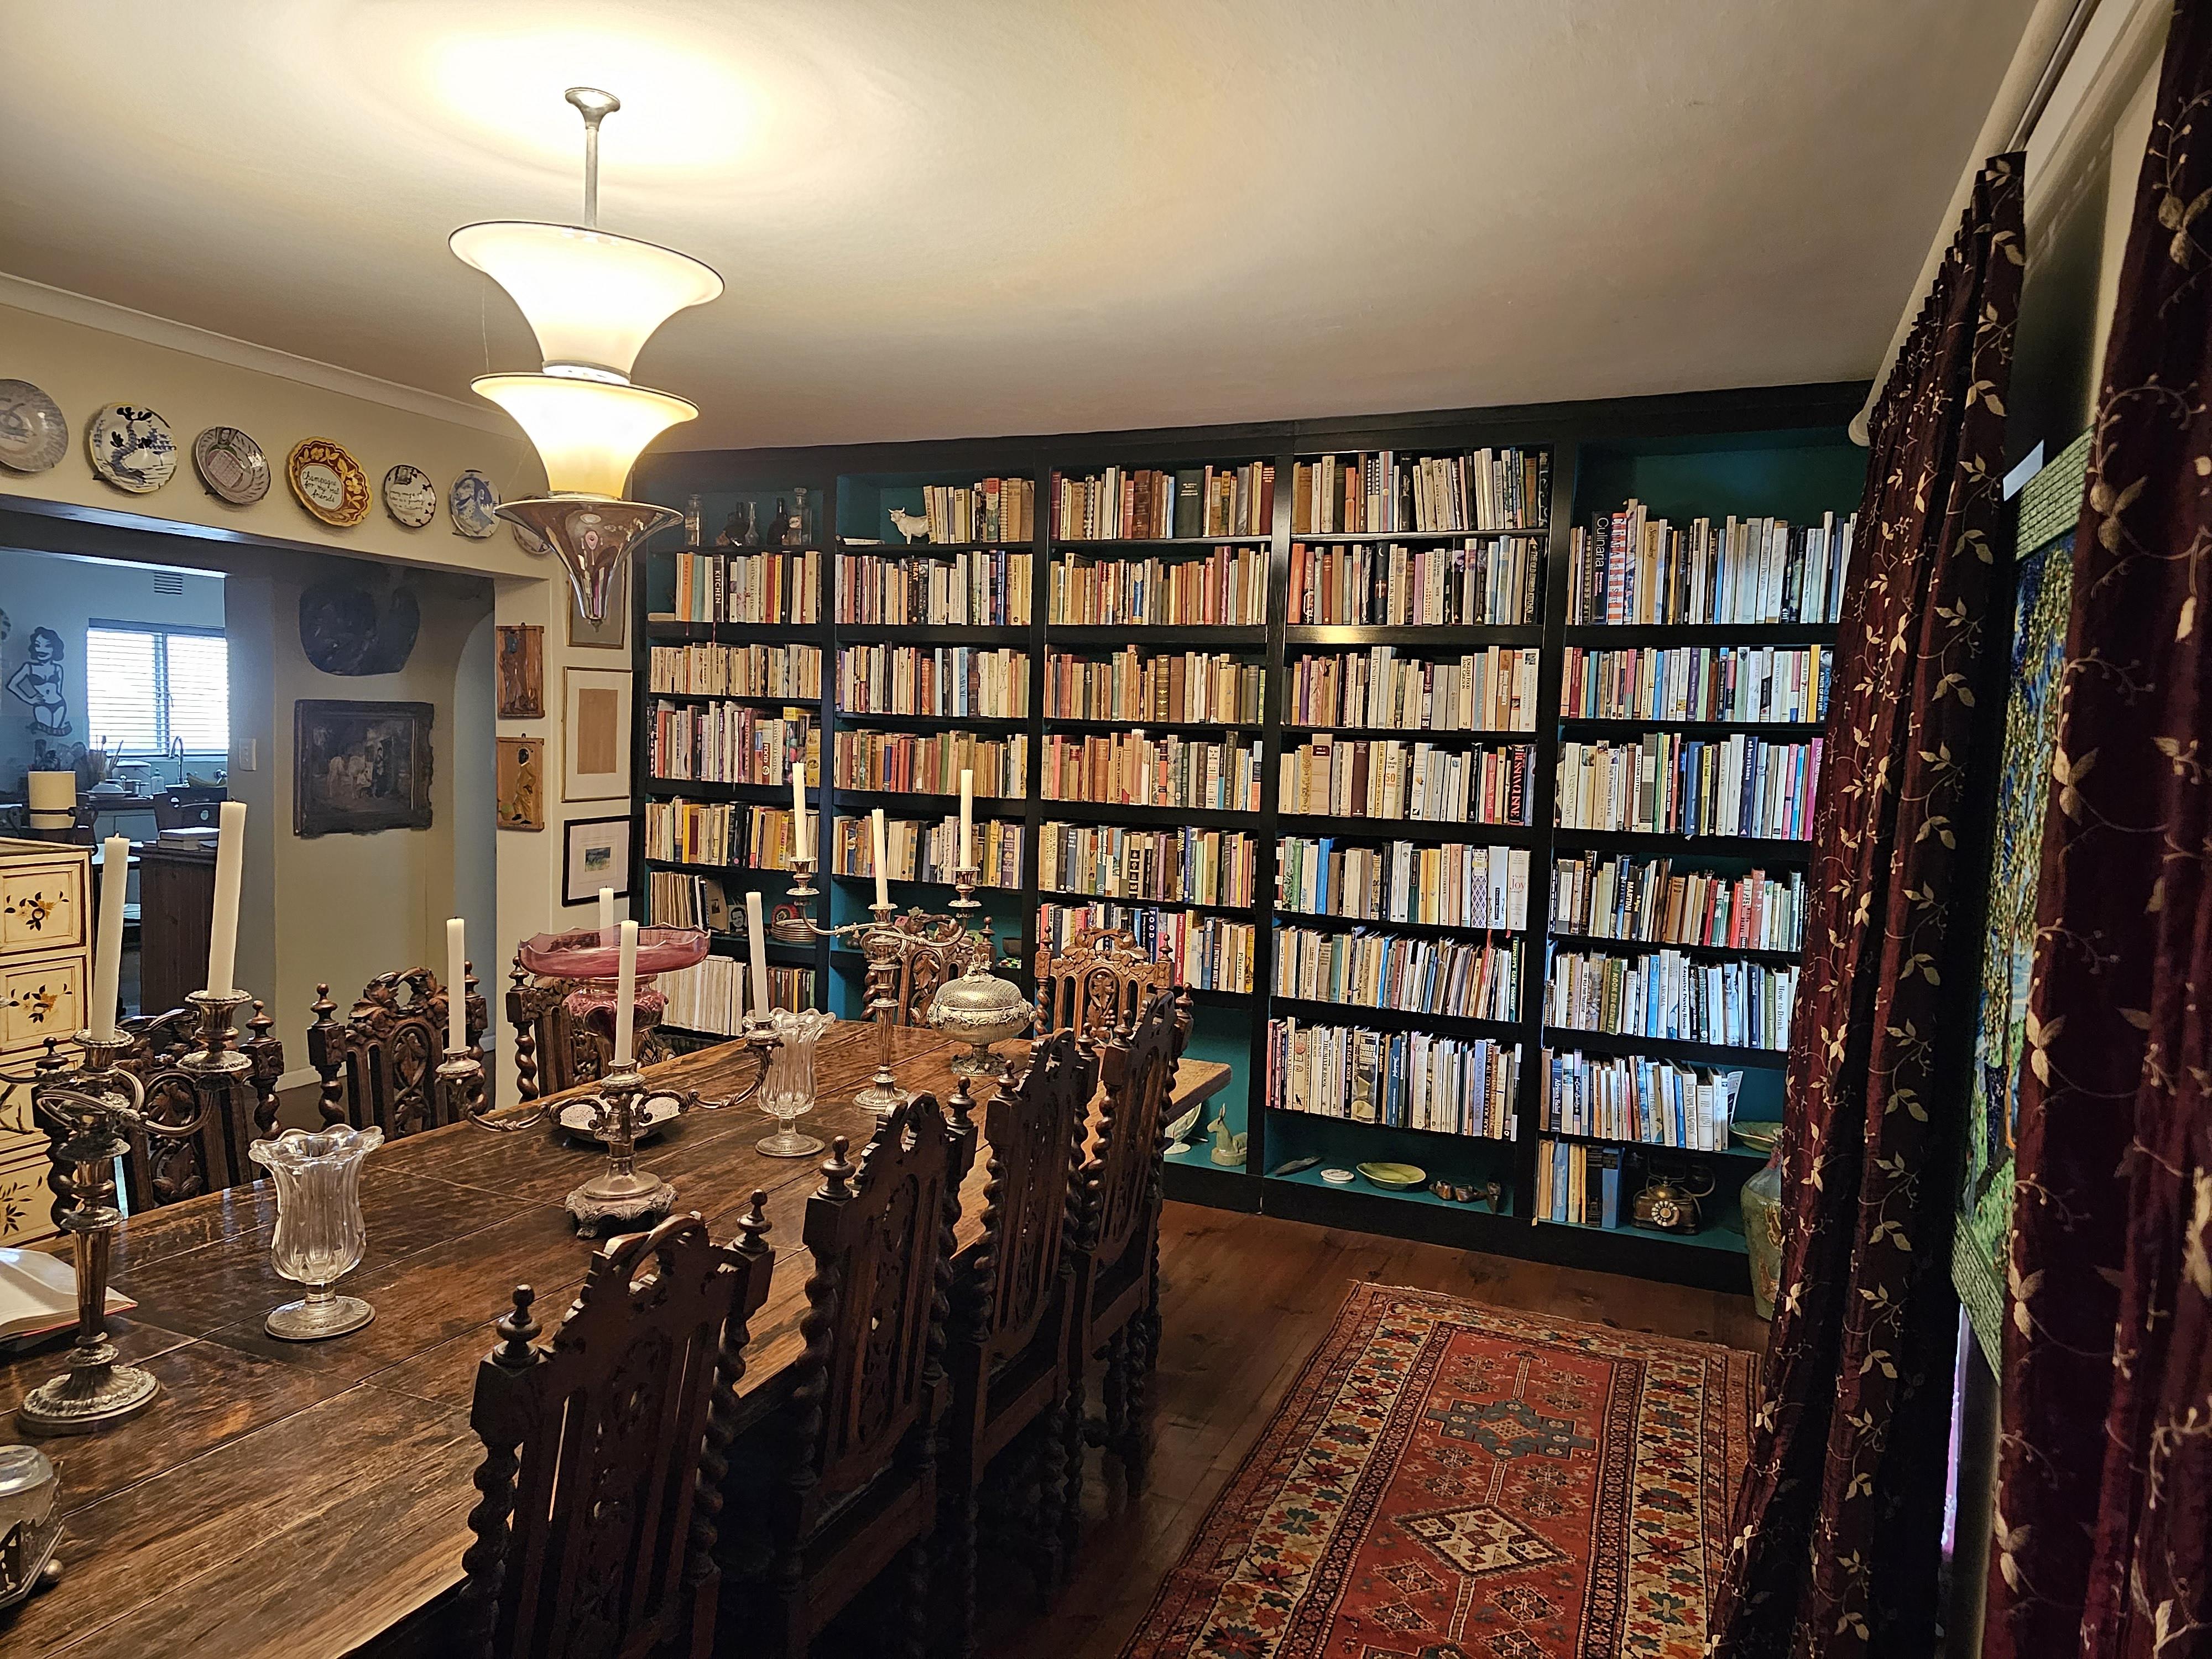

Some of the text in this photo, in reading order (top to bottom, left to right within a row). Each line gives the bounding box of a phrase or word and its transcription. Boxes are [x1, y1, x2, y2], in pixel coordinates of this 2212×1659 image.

[1595, 517, 1609, 567] Culinaria
[1385, 773, 1396, 782] 50
[1510, 752, 1525, 817] RUSSIAN CUISINE
[1509, 878, 1525, 890] Joy
[1624, 881, 1634, 911] MARTINI
[1610, 993, 1617, 1003] EN
[1608, 1003, 1616, 1029] GENIET
